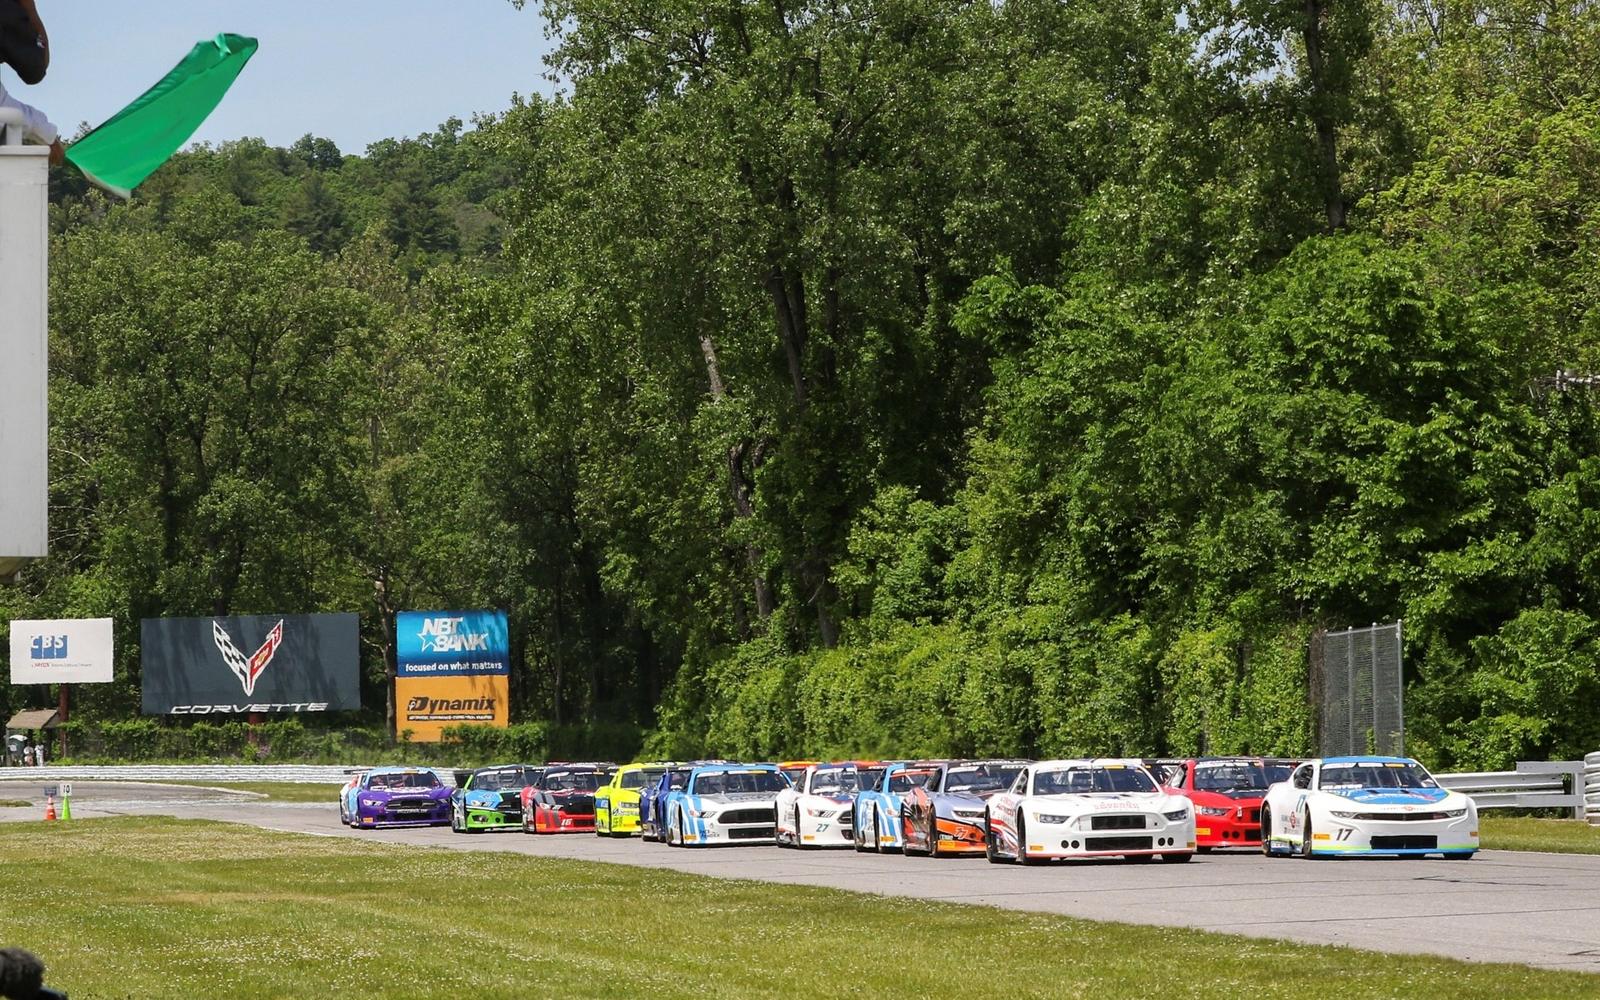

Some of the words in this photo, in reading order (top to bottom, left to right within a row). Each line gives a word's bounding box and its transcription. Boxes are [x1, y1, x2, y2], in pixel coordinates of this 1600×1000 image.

[423, 617, 463, 635] NBT
[433, 633, 488, 652] BANK
[405, 663, 437, 672] focused
[450, 662, 470, 670] what
[472, 661, 503, 670] matters
[170, 702, 329, 714] CORVETTE
[408, 696, 496, 713] Dynamix
[816, 823, 830, 832] 27
[1335, 828, 1354, 841] 17
